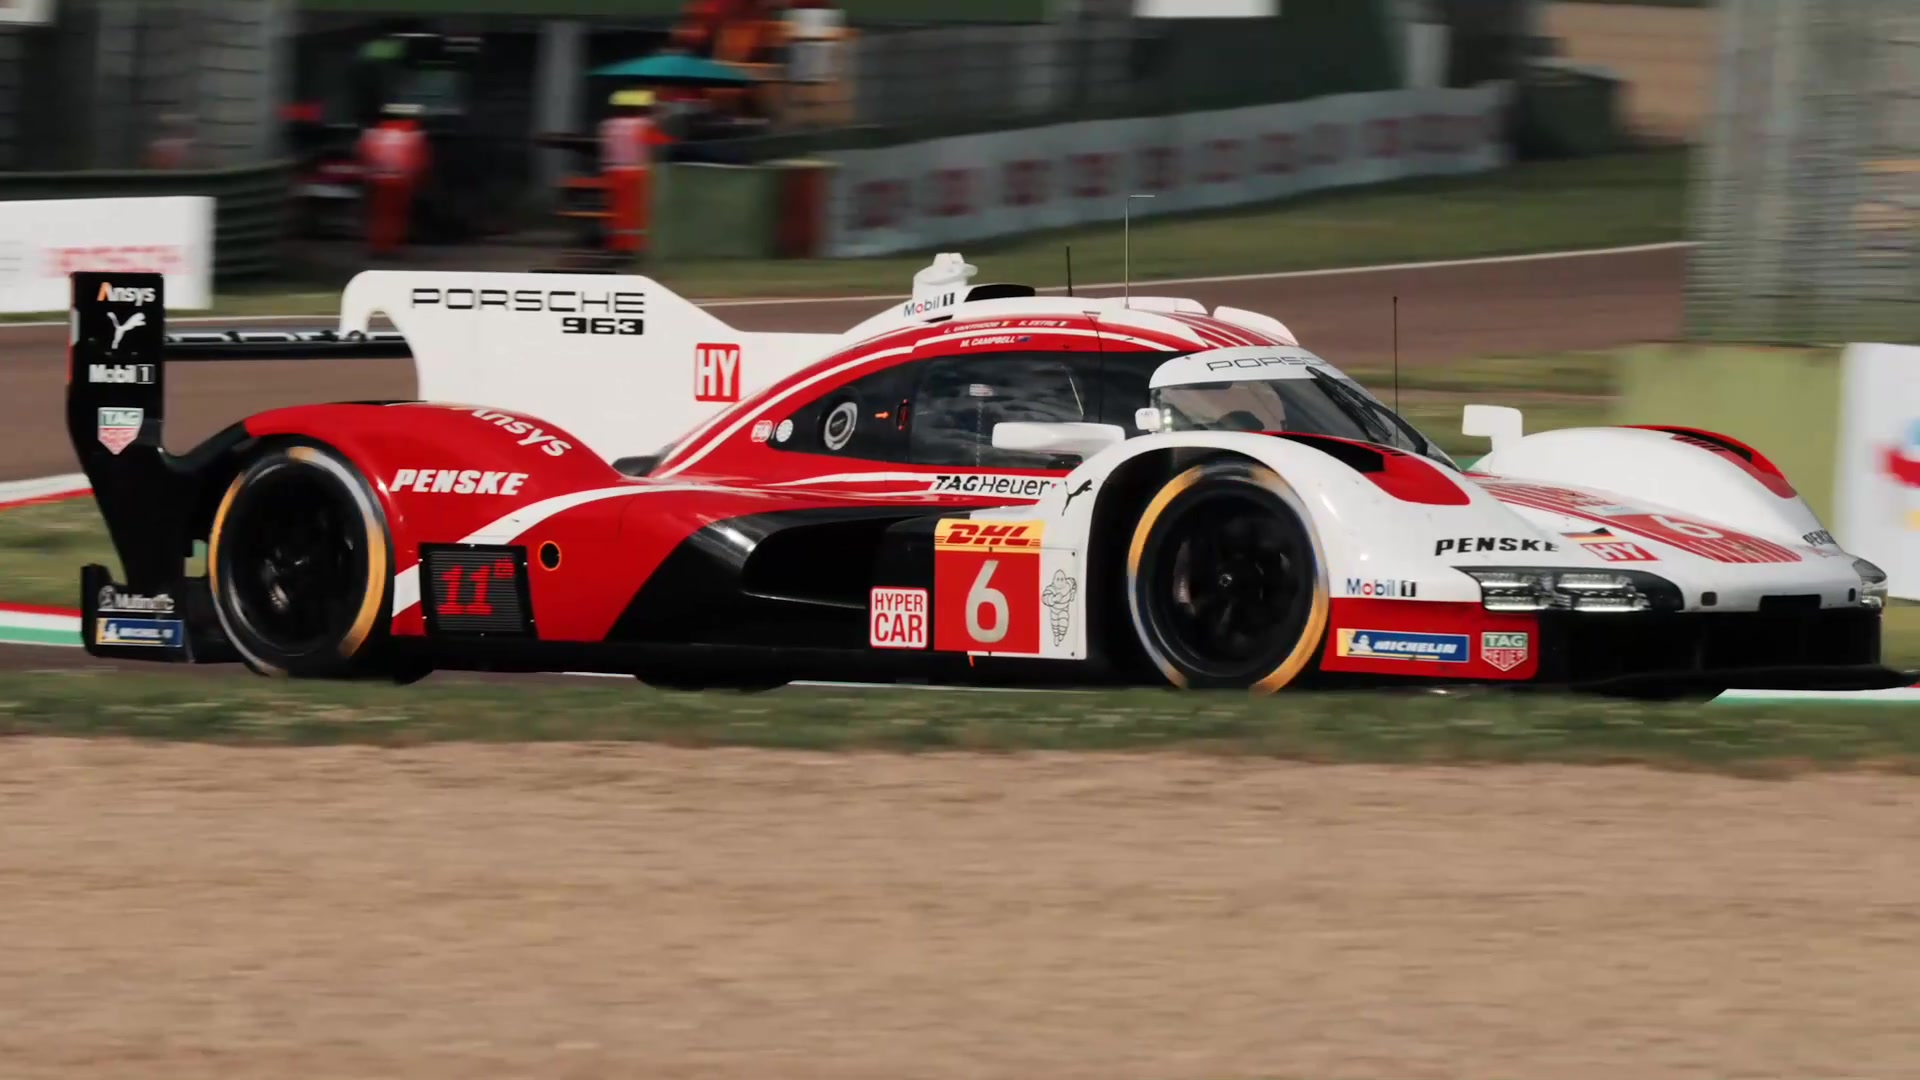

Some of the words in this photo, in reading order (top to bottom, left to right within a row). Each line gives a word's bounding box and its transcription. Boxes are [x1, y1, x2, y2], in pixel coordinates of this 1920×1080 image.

[97, 282, 155, 306] Ansys
[412, 288, 644, 313] PORSCHE
[904, 296, 939, 317] Mobil
[942, 292, 955, 307] 1
[562, 317, 644, 335] 963
[971, 336, 1016, 347] CAMPBELL
[88, 364, 136, 383] Mobil
[138, 364, 153, 384] 1
[696, 348, 739, 397] HY
[101, 410, 141, 426] TAG
[389, 468, 529, 495] PENSKE
[945, 523, 1031, 546] DHL
[1649, 515, 1725, 539] 6
[1435, 537, 1560, 556] PENSKE
[1582, 543, 1646, 560] HY
[1346, 578, 1396, 596] Mobil
[1401, 580, 1416, 597] 1
[875, 592, 923, 612] HYPER
[965, 560, 1010, 643] 6
[874, 612, 923, 643] CAR
[1372, 640, 1458, 654] MICHELIN
[1485, 634, 1524, 647] TAG
